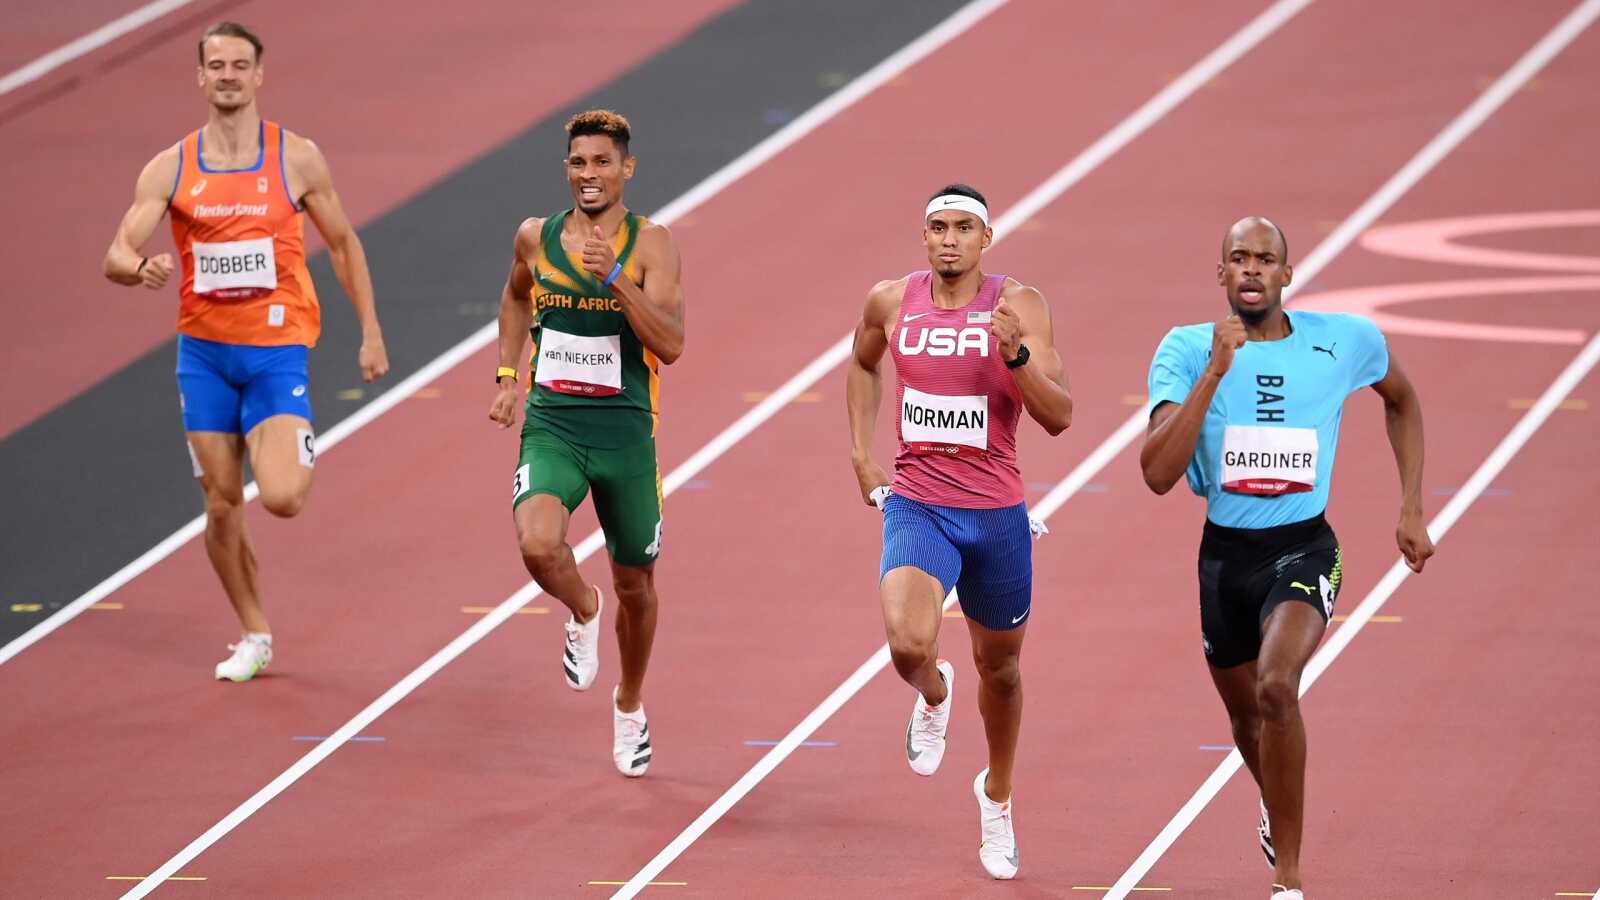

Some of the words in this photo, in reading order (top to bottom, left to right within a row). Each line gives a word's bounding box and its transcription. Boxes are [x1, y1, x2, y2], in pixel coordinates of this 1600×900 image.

[200, 252, 267, 274] DOBBER
[537, 294, 572, 310] OUTH
[577, 297, 624, 312] AFRIC
[898, 327, 989, 357] USA
[545, 349, 562, 361] van
[564, 351, 614, 366] NIEKERK
[1256, 374, 1285, 423] BAH
[904, 401, 984, 429] NORMAN
[1225, 451, 1313, 469] GARDINER
